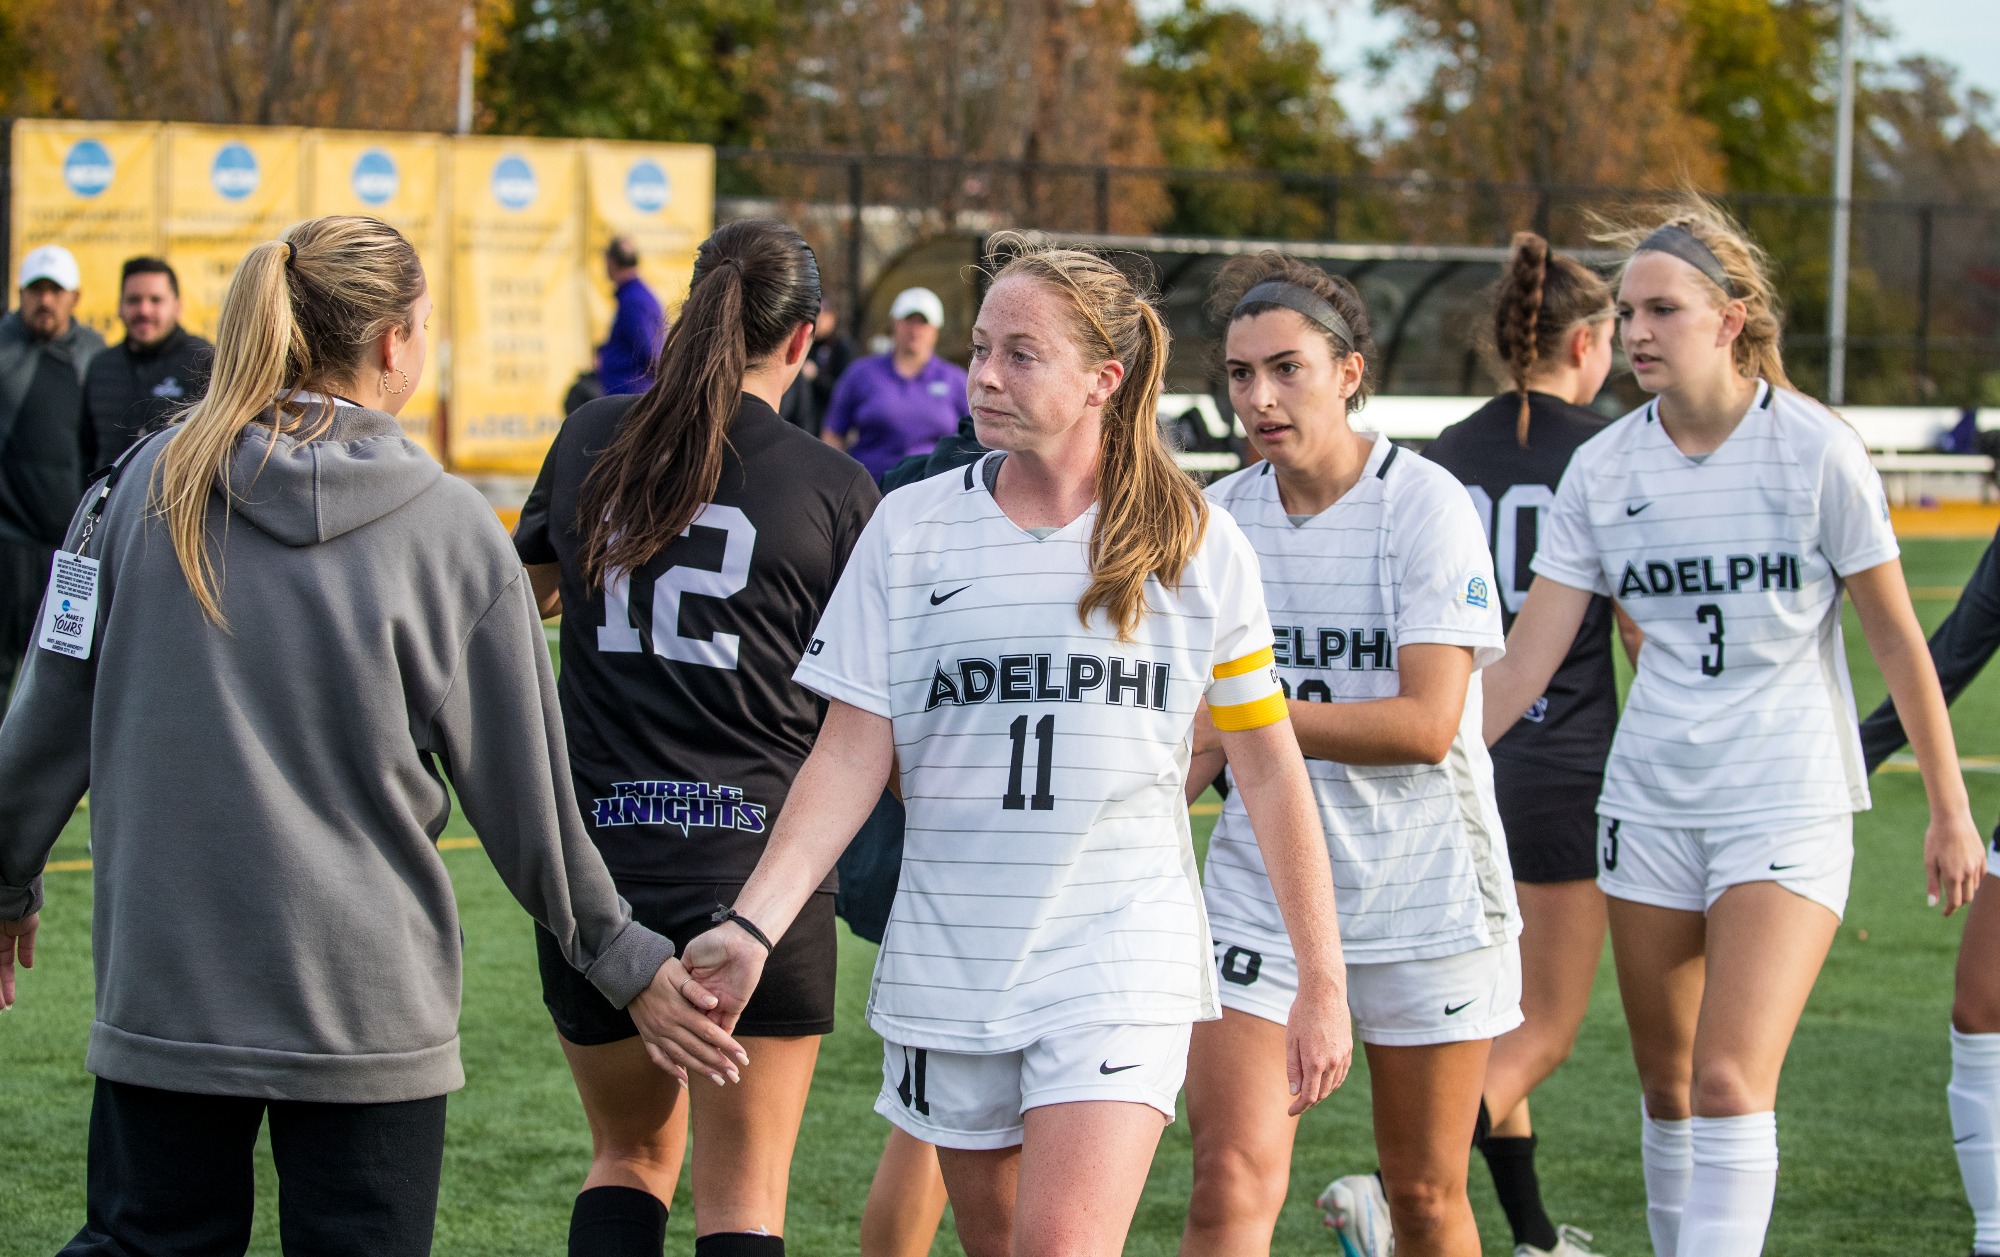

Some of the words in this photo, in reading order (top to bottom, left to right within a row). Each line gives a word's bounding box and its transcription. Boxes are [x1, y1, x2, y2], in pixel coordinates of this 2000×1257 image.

[596, 502, 757, 670] 12
[1470, 581, 1486, 599] 50
[1619, 552, 1802, 600] ADELPHI
[65, 613, 79, 621] MAKE
[1697, 604, 1724, 677] 3
[1272, 626, 1394, 670] ELPHI
[925, 653, 1170, 712] ADELPHI
[1002, 714, 1055, 810] 11
[611, 780, 743, 800] PURPLE
[593, 796, 766, 838] KNIGHTS
[1604, 818, 1620, 871] 3
[1213, 940, 1262, 986] 0
